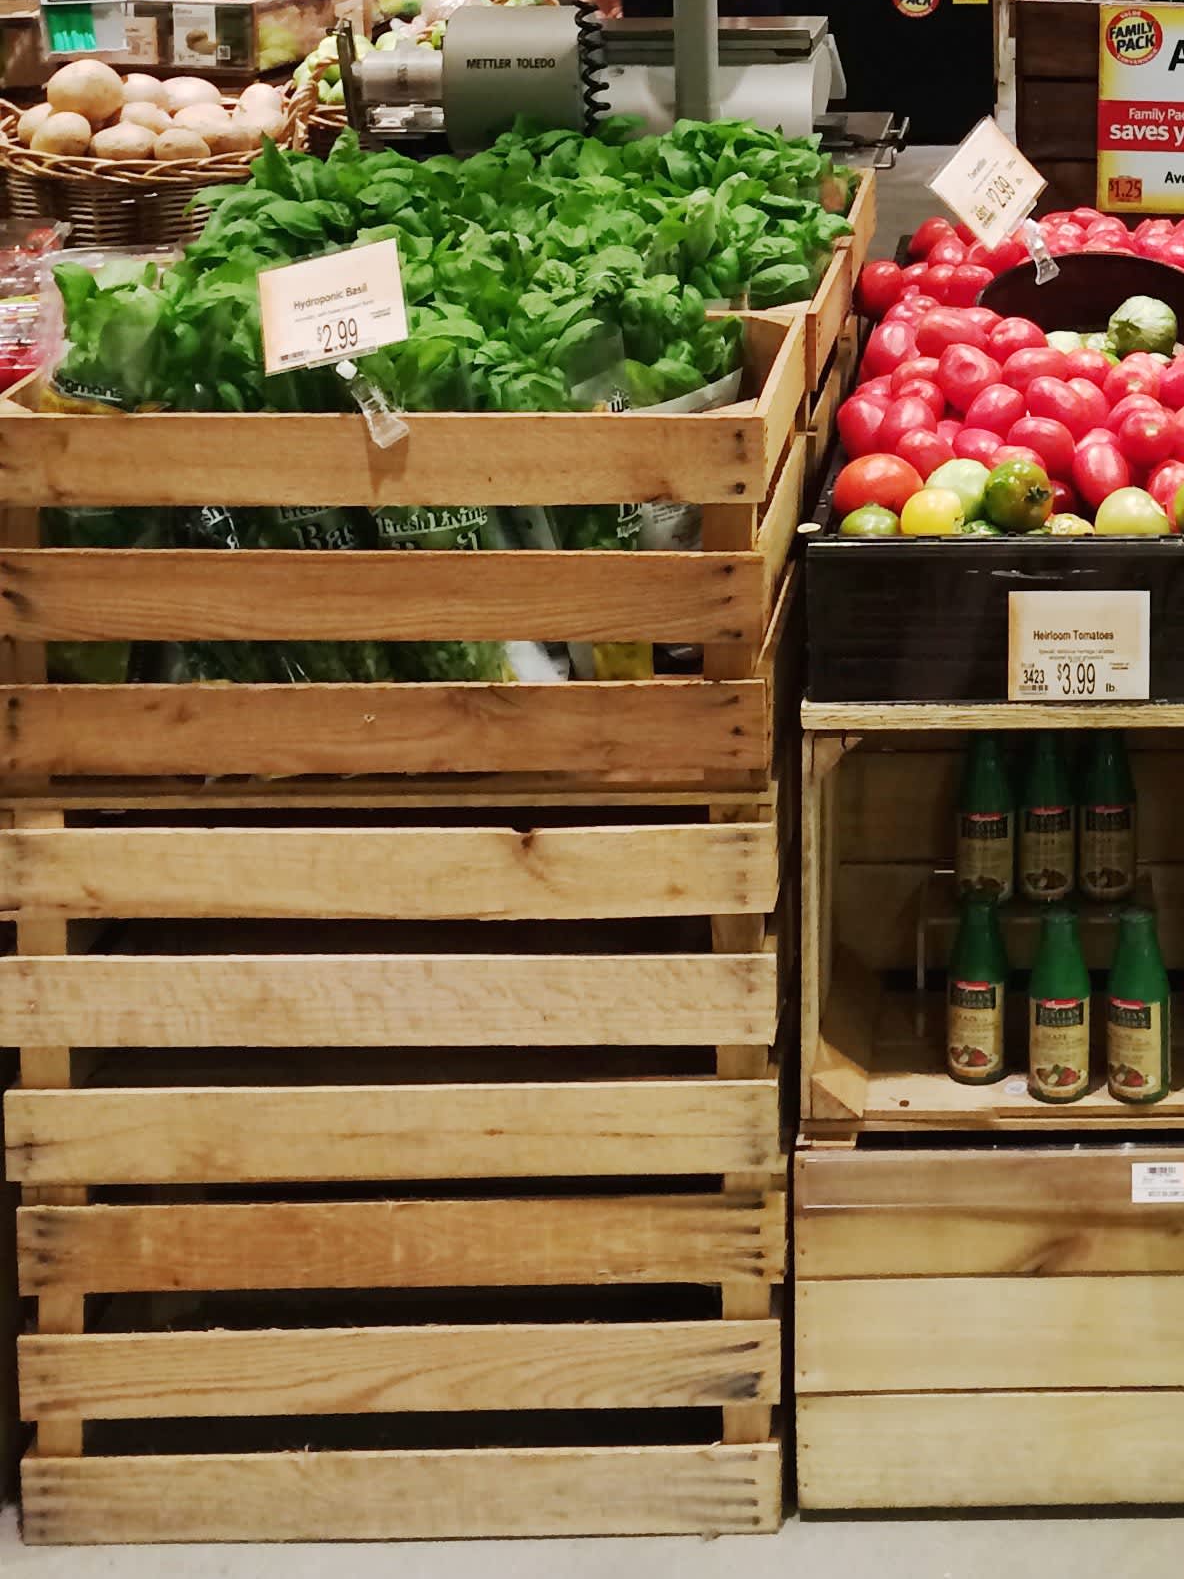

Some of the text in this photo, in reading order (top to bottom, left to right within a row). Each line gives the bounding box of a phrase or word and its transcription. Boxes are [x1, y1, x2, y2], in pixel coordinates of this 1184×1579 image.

[1110, 22, 1155, 39] FAMILY
[1116, 34, 1155, 54] PACK
[466, 58, 556, 69] METTLER TOLEDO
[1128, 107, 1166, 122] Family
[1109, 124, 1169, 141] saves
[1108, 179, 1143, 199] $1.25
[293, 282, 369, 311] Hydroponic Basil
[316, 317, 359, 354] $2.99
[377, 512, 425, 535] Fresh
[1033, 629, 1115, 641] Heirloom Tomatoes
[1023, 669, 1045, 683] 3423
[1057, 662, 1096, 695] $3.99
